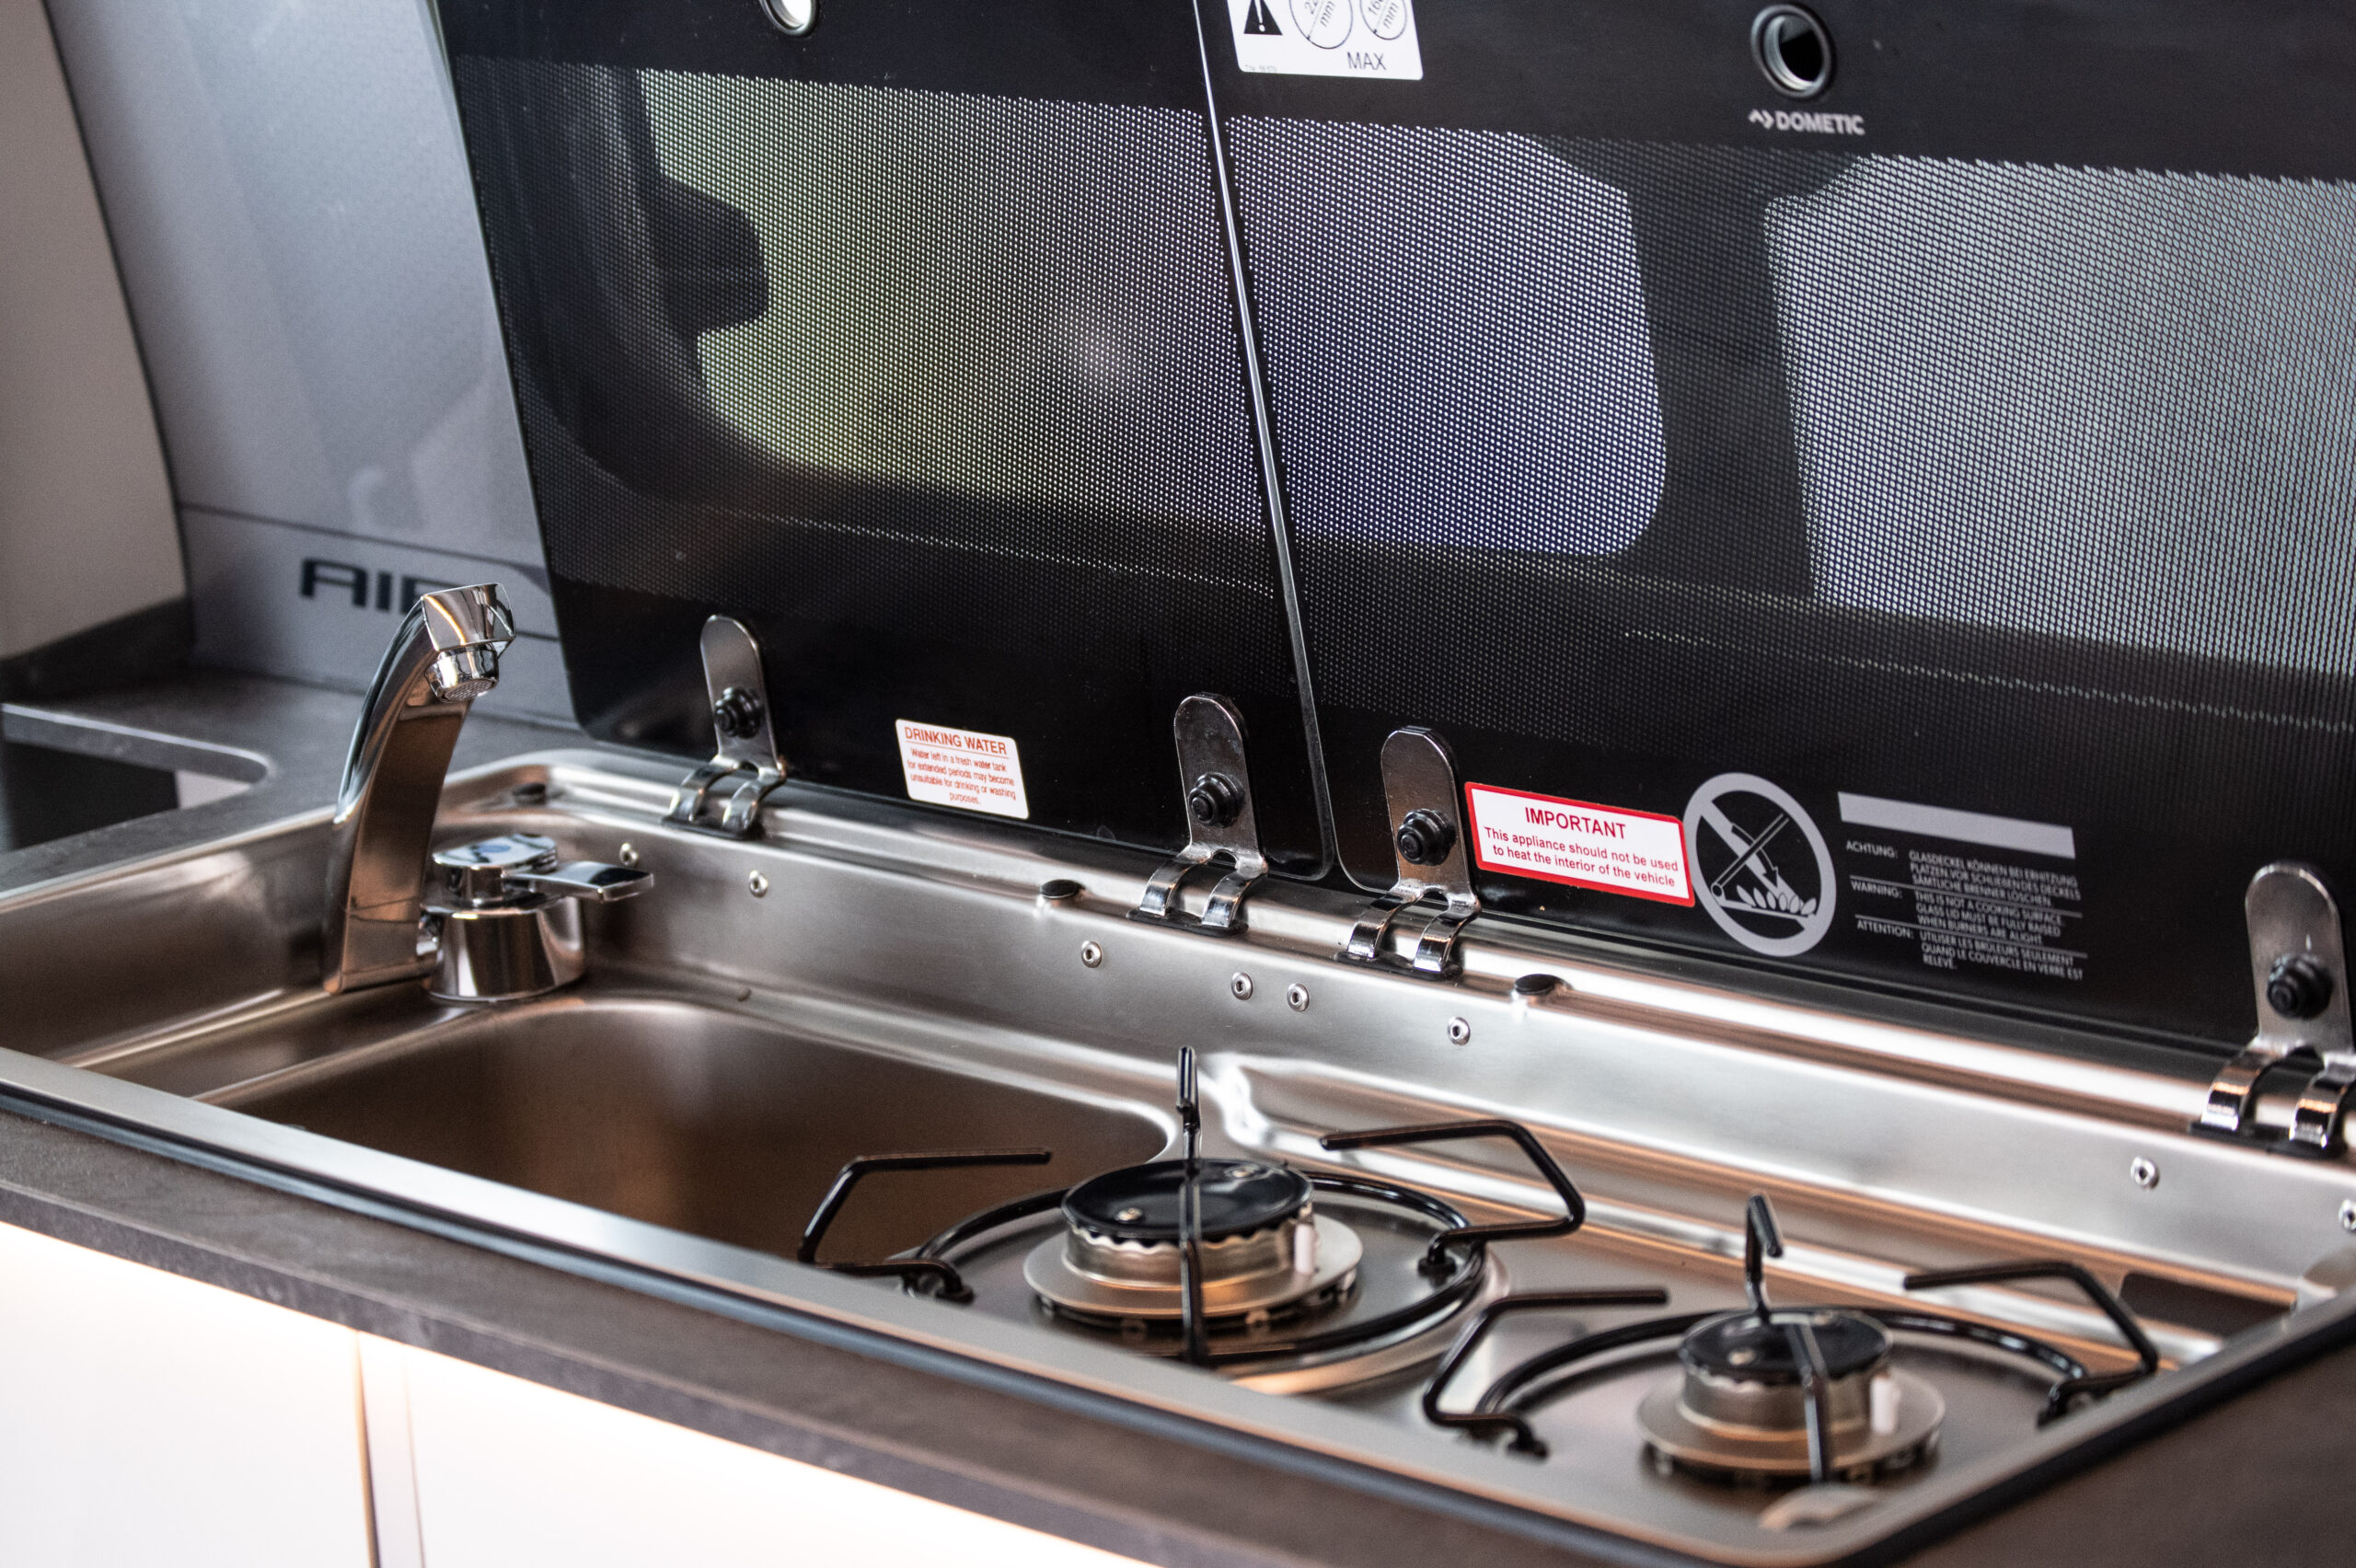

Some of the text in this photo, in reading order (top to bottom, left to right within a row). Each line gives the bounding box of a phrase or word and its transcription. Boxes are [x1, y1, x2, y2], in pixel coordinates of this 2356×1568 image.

[1383, 3, 1399, 29] mm
[1346, 52, 1387, 71] MAX
[1774, 110, 1866, 135] DOMETIC
[904, 726, 1007, 755] DRINKING WATER
[907, 760, 1014, 786] for extended periods may become
[910, 747, 1007, 772] Water left in a fresh water tank
[910, 774, 1016, 801] unsuitable for drinking or washing
[949, 792, 981, 805] purposes.
[1525, 806, 1626, 839] IMPORTANT
[1484, 825, 1679, 872] This appliance should not be used
[1846, 839, 1898, 859] ACHTUNG:
[1909, 850, 1965, 870] GLASDECKEL
[1493, 845, 1675, 887] to heat the interior of the vehicle
[1850, 880, 1902, 898] WARNING:
[1914, 891, 1934, 904] THIS
[1935, 894, 1945, 905] IS
[1946, 895, 1965, 908] NOT
[1967, 900, 1975, 909] A
[1975, 901, 2020, 918] COOKING
[1949, 870, 1969, 882] VOR
[2039, 883, 2082, 901] DECKELS
[1964, 882, 2006, 899] BRENNER
[1915, 903, 2061, 938] GLASS LID MUST BE FULLY RAISED
[1917, 914, 1946, 928] WHEN
[1947, 919, 1989, 937] BURNERS
[1990, 927, 2006, 939] ARE
[1856, 919, 1913, 940] ATTENTION:
[1919, 930, 1957, 946] UTILISER
[1958, 936, 1974, 950] LES
[2020, 949, 2073, 966] SEULEMENT
[1921, 941, 2083, 981] QUAND LE COUVERCLE EN VERRE EST
